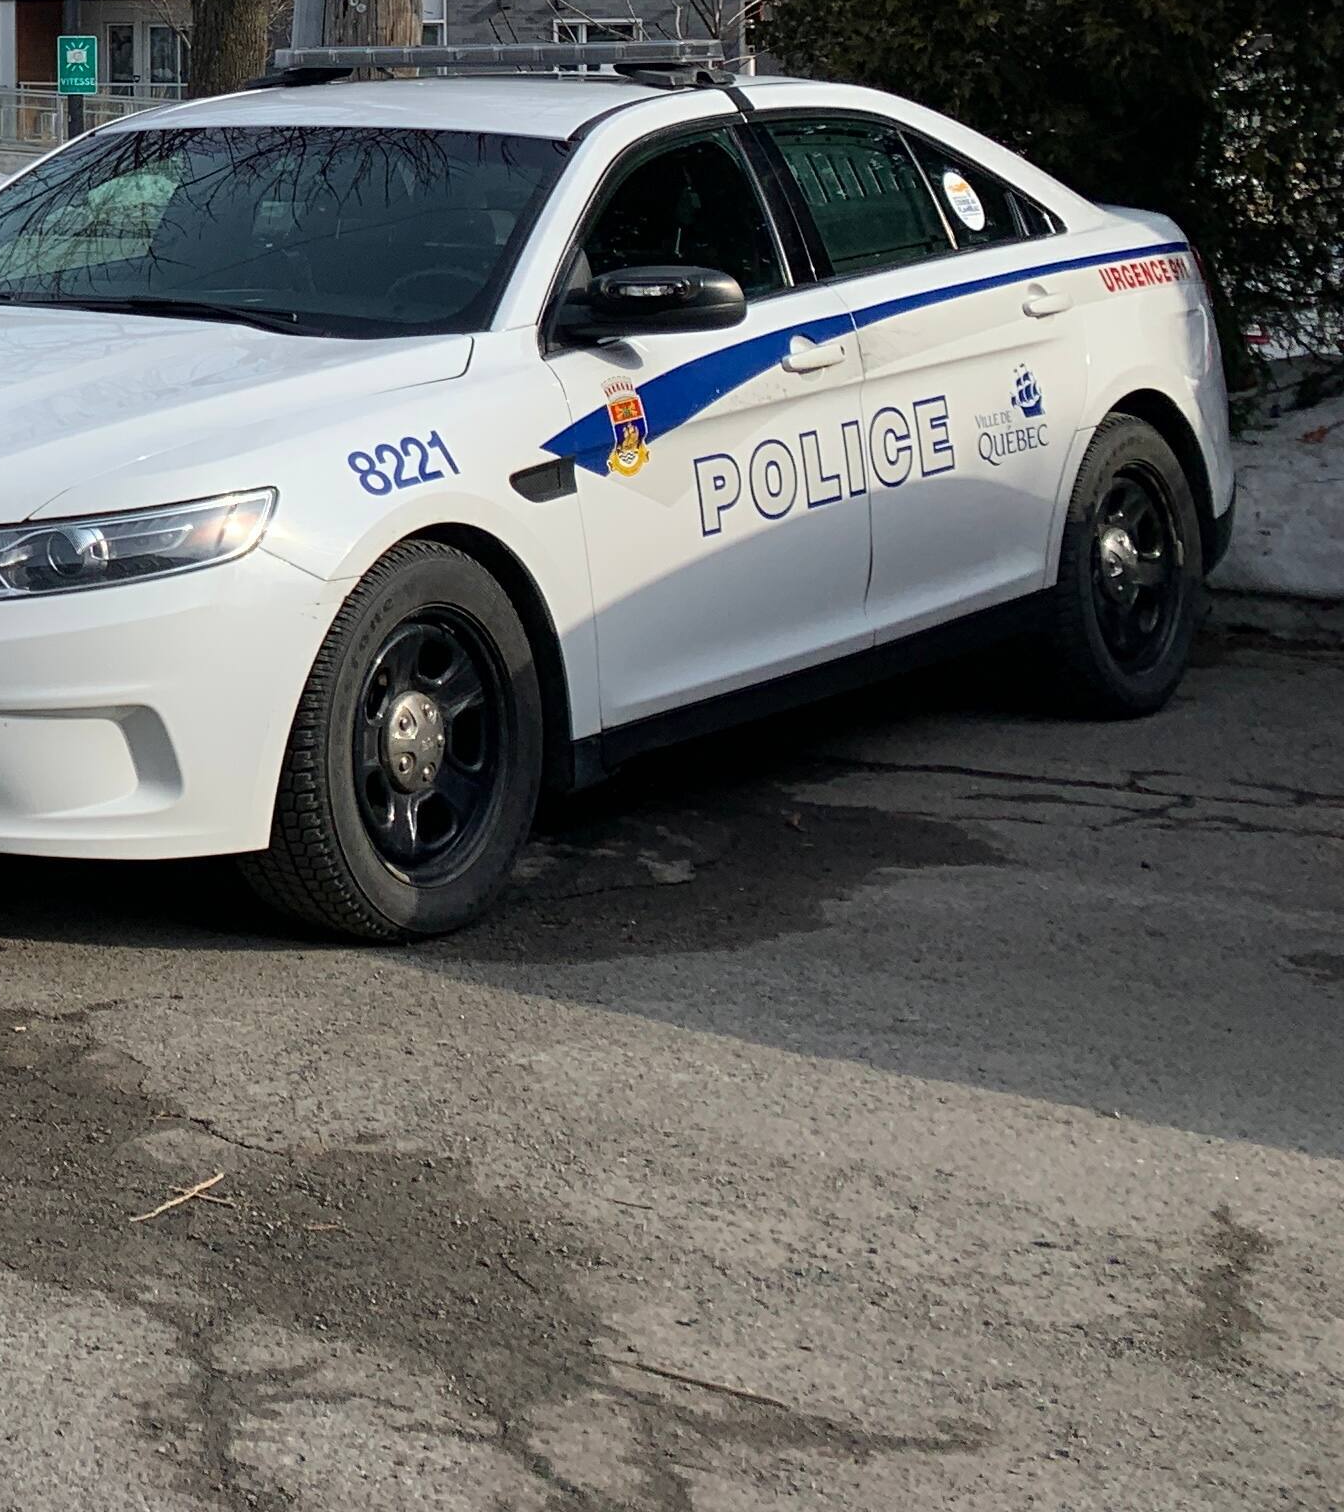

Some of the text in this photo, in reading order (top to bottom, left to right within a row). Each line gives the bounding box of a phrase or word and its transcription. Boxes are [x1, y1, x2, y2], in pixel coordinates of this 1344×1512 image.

[60, 78, 95, 86] VITESSE
[1098, 257, 1190, 292] URGENCE 911
[975, 410, 1012, 429] VILLE DE
[347, 430, 461, 496] 8221
[978, 424, 1049, 466] QUÉBEC
[693, 395, 956, 537] POLICE
